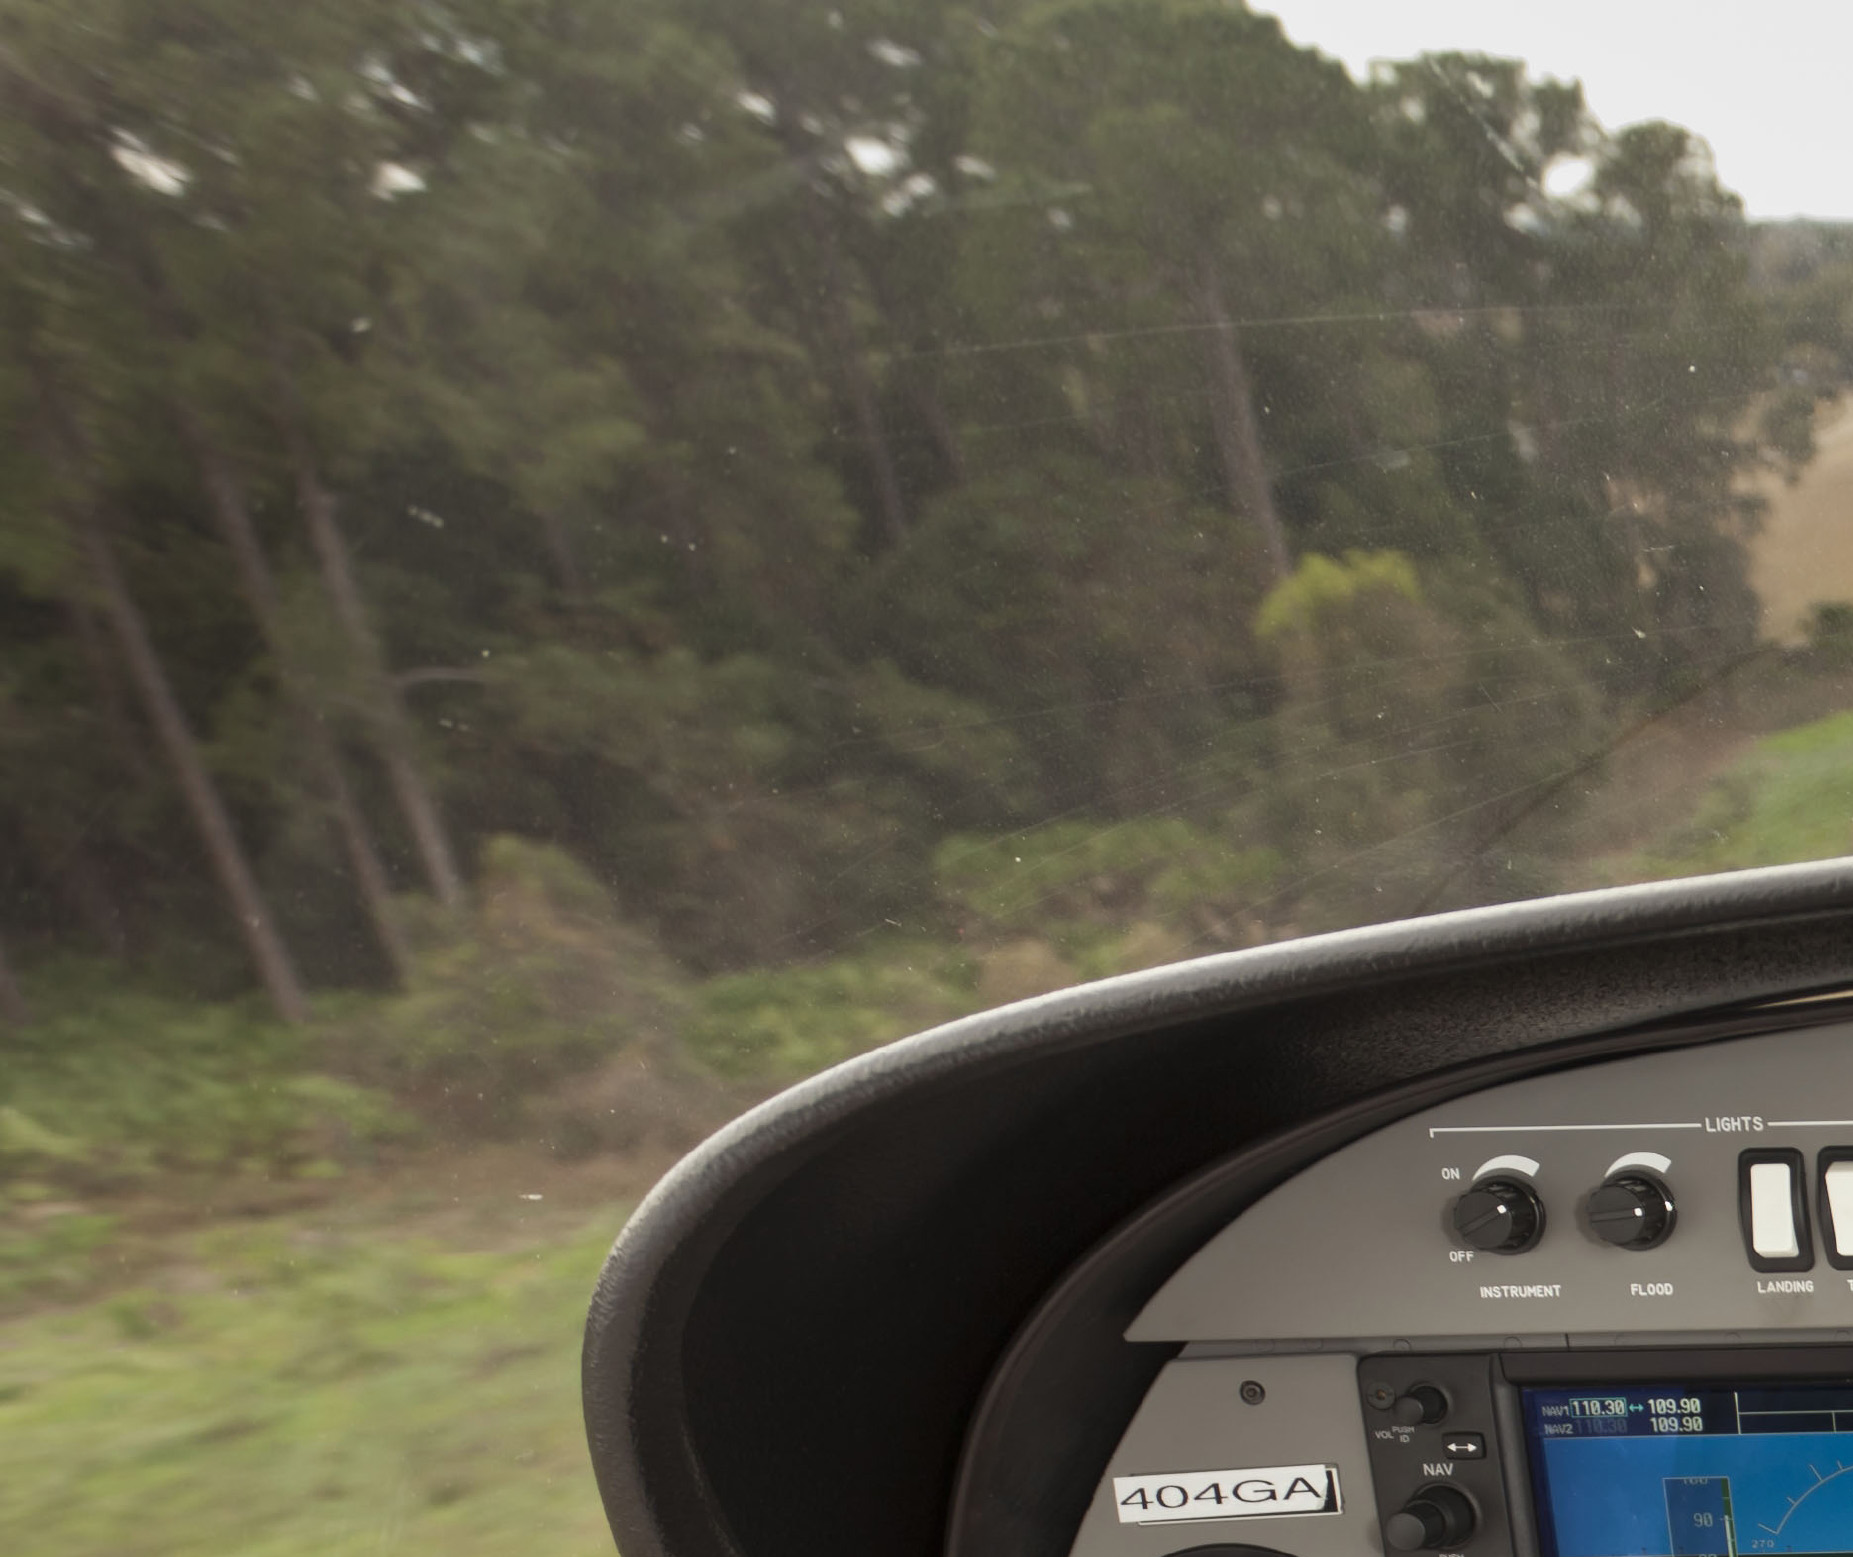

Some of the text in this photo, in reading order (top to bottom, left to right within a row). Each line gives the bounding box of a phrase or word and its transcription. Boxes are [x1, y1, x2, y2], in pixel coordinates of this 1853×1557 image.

[1705, 1117, 1763, 1132] LIGHTS
[1442, 1168, 1460, 1179] ON
[1450, 1249, 1473, 1262] OFF
[1480, 1285, 1561, 1298] INSTRUMENT
[1631, 1283, 1673, 1296] FLOOD
[1758, 1281, 1814, 1293] LANDING
[1573, 1398, 1700, 1416] 110.30 109.90
[1651, 1417, 1703, 1432] 109.90
[1423, 1463, 1453, 1475] NAV
[1121, 1478, 1321, 1509] 404GA
